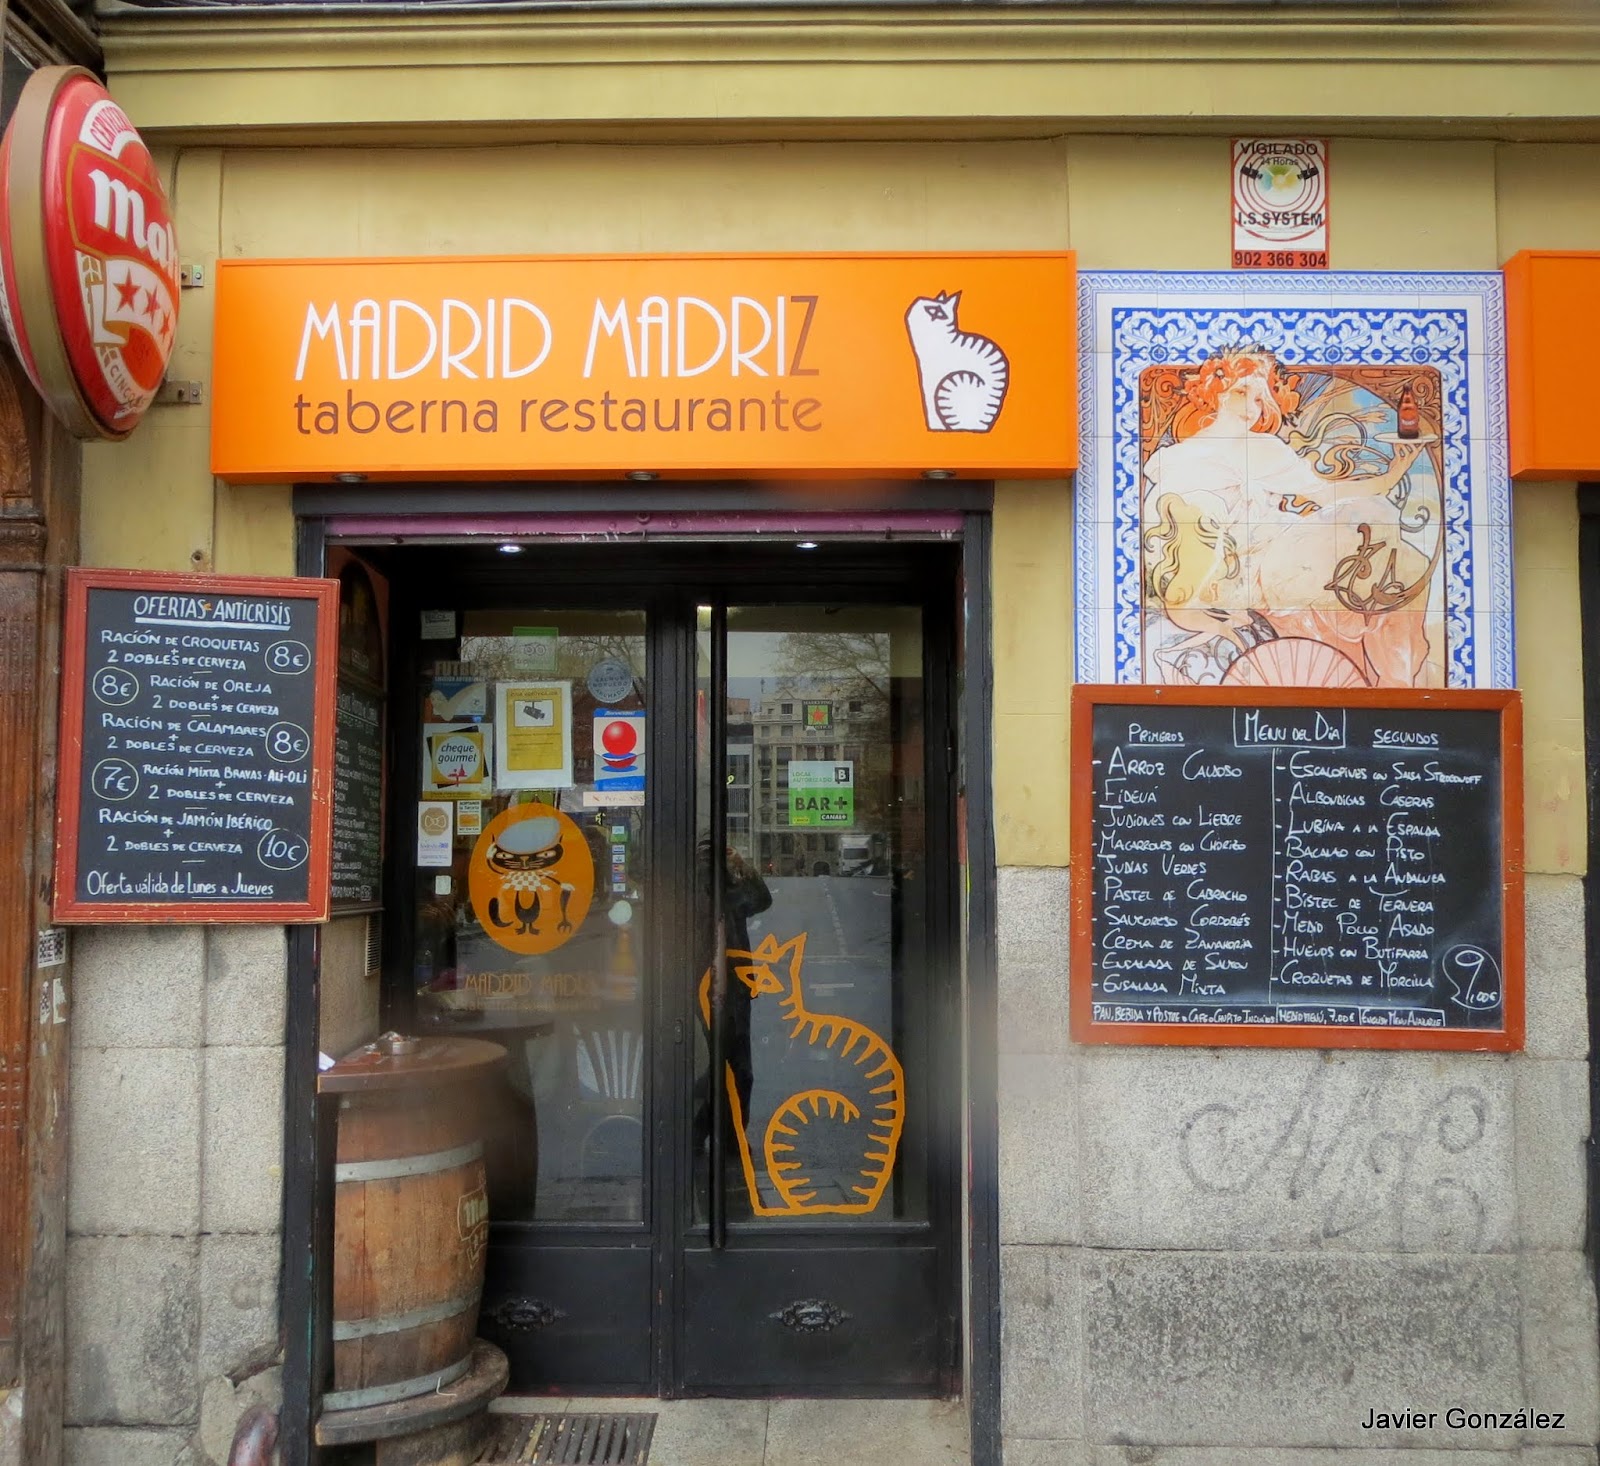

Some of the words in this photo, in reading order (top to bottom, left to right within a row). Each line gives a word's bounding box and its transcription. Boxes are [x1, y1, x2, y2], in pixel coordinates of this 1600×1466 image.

[1241, 142, 1318, 155] VIGILADO
[1273, 157, 1298, 166] Horas
[1234, 252, 1262, 266] 902
[1266, 252, 1294, 266] 366
[1299, 252, 1327, 267] 304
[294, 297, 553, 382] MADRID
[583, 294, 821, 379] MADRIZ
[294, 389, 498, 435] taberna
[520, 388, 823, 434] restaurante
[134, 595, 206, 620] OFERTAS
[212, 599, 291, 625] ANTICRISIS
[101, 629, 161, 645] RACIÓN
[165, 636, 178, 646] DE
[182, 635, 260, 653] CROQUETAS
[107, 650, 119, 663] 2
[124, 653, 179, 665] DOBLES
[182, 656, 195, 666] DE
[198, 656, 246, 671] CERVEZA
[274, 645, 304, 667] 8€
[102, 675, 132, 697] 8€
[150, 675, 199, 689] RACIÓN
[205, 681, 218, 691] DE
[224, 679, 272, 694] OREJA
[153, 695, 162, 709] 2
[169, 700, 218, 711] DOBLES
[221, 704, 233, 713] DE
[236, 702, 279, 715] CERVEZA
[102, 713, 162, 730] RACIÓN
[168, 721, 181, 731] DE
[187, 720, 267, 737] CALAMARES
[1129, 723, 1185, 742] PRIMEROS
[1244, 709, 1286, 742] MENU
[1292, 728, 1311, 742] DEL
[107, 736, 118, 750] 2
[126, 739, 175, 751] DOBLES
[179, 744, 192, 752] DE
[195, 742, 254, 757] CERVEZA
[274, 731, 304, 754] 8€
[441, 743, 474, 753] cheque
[1373, 729, 1439, 745] SEGUNDOS
[438, 753, 477, 764] gourmet
[1108, 746, 1166, 775] ARROZ
[1182, 749, 1243, 780] CALDOSO
[1290, 751, 1367, 779] ESCALOPINES
[1373, 772, 1388, 781] CON
[1392, 762, 1421, 781] SALSA
[103, 766, 131, 792] 7€
[143, 764, 184, 776] RACIÓN
[188, 766, 221, 778] MIXTA
[149, 785, 159, 799] 2
[167, 789, 216, 800] DOBLES
[219, 793, 232, 801] DE
[236, 792, 294, 806] CERVEZA
[1380, 784, 1434, 809] CASERAS
[99, 808, 158, 824] RACIÓN
[161, 817, 173, 825] DE
[177, 812, 223, 827] JAMÓN
[226, 814, 273, 831] IBÉRICO
[1099, 805, 1164, 827] JUDIONES
[1172, 814, 1192, 825] CON
[1199, 805, 1242, 826] LIEBRE
[1353, 825, 1360, 833] A
[1368, 824, 1378, 834] LA
[1387, 812, 1441, 837] ESPALDA
[107, 836, 119, 851] 2
[125, 841, 169, 851] DOBLES
[172, 843, 185, 851] DE
[189, 842, 242, 854] CERVEZA
[265, 835, 300, 861] 10€
[1100, 830, 1172, 853] MACARRONES
[1179, 843, 1194, 851] CON
[1200, 830, 1246, 851] CHORIZO
[1285, 836, 1349, 859] BACALAO
[1356, 849, 1375, 858] CON
[1387, 836, 1425, 862] PISTO
[1162, 853, 1207, 875] VERDES
[1285, 860, 1337, 883] RABAS
[1349, 875, 1357, 883] A
[1364, 875, 1377, 884] LA
[87, 870, 133, 896] Oferta
[171, 871, 185, 894] de
[188, 872, 216, 894] Lunes
[221, 884, 228, 894] a
[231, 872, 274, 895] Jueves
[1104, 877, 1153, 901] PASTEL
[1163, 891, 1176, 901] DE
[1187, 879, 1247, 901] CABRACHO
[1285, 883, 1338, 909] BISTEC
[1349, 899, 1361, 910] DE
[1369, 886, 1434, 912] TERNERA
[1104, 905, 1178, 926] SALMOREJO
[1190, 904, 1250, 927] CORDOBÉS
[1282, 910, 1324, 935] MEDIO
[1336, 912, 1379, 935] POLLO
[1388, 914, 1435, 938] ASADO
[1102, 928, 1154, 949] CREMA
[1160, 941, 1173, 949] DE
[1185, 928, 1253, 950] ZANAHORIA
[1284, 936, 1334, 958] HUEVOS
[1340, 948, 1357, 958] CON
[1362, 936, 1428, 960] BUTIFARRA
[1102, 952, 1173, 970] ENSALADA
[1183, 960, 1196, 971] DE
[1103, 974, 1168, 993] ENSALADA
[1179, 974, 1226, 996] MIXTA
[1281, 960, 1352, 986] CROQUETAS
[1361, 974, 1372, 986] DE
[1378, 960, 1434, 989] MORCILLA
[1147, 1010, 1151, 1022] Y
[1153, 1006, 1180, 1022] POSTRE
